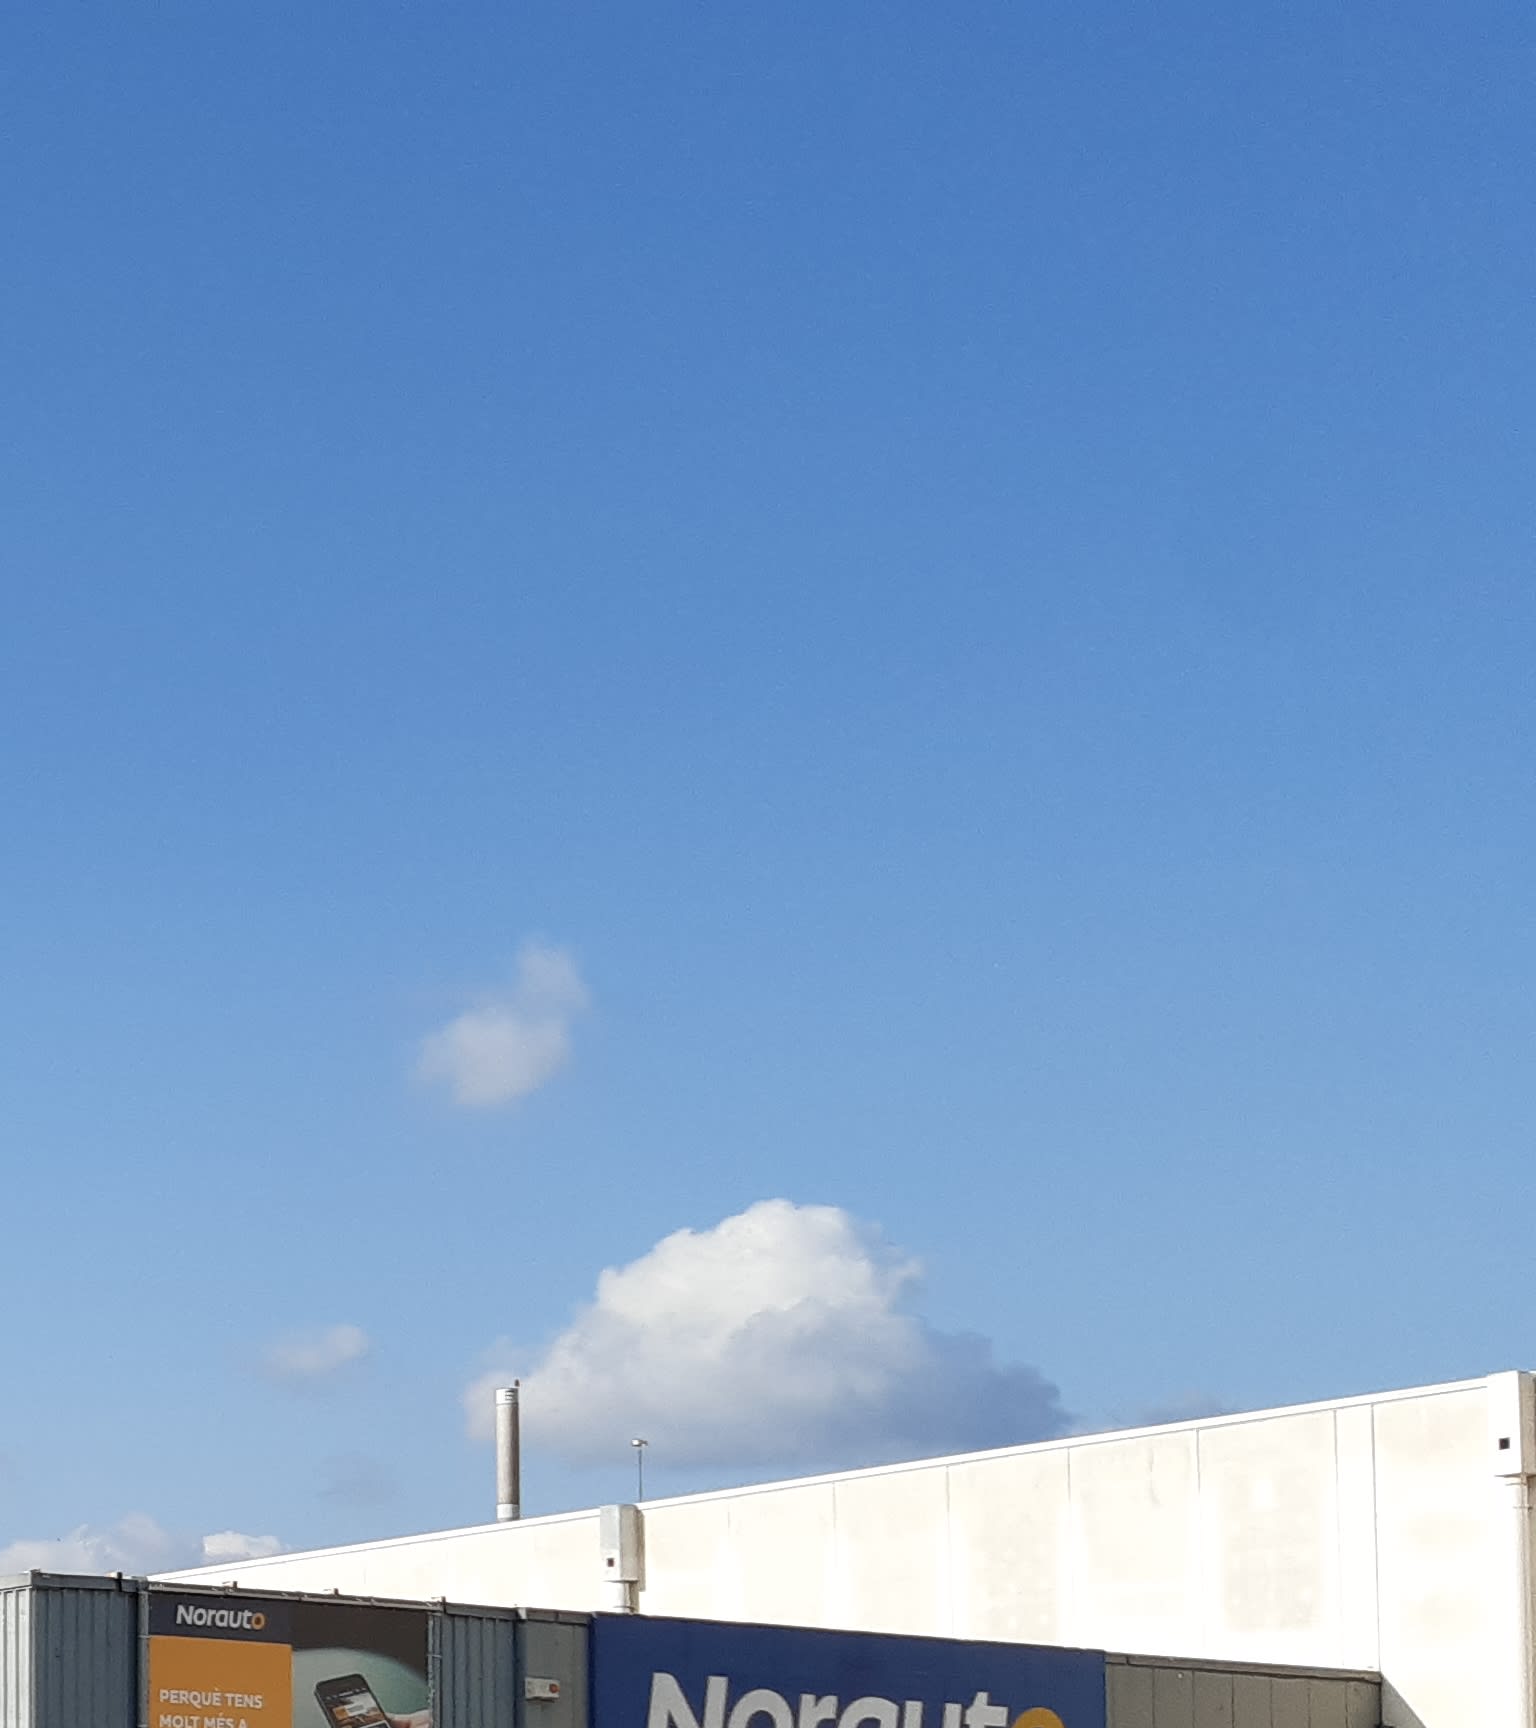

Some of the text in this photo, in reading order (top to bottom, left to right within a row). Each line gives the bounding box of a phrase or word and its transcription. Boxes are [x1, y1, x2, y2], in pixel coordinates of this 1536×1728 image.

[175, 1604, 266, 1630] Norauto
[159, 1687, 263, 1708] PERQUÈ TENS
